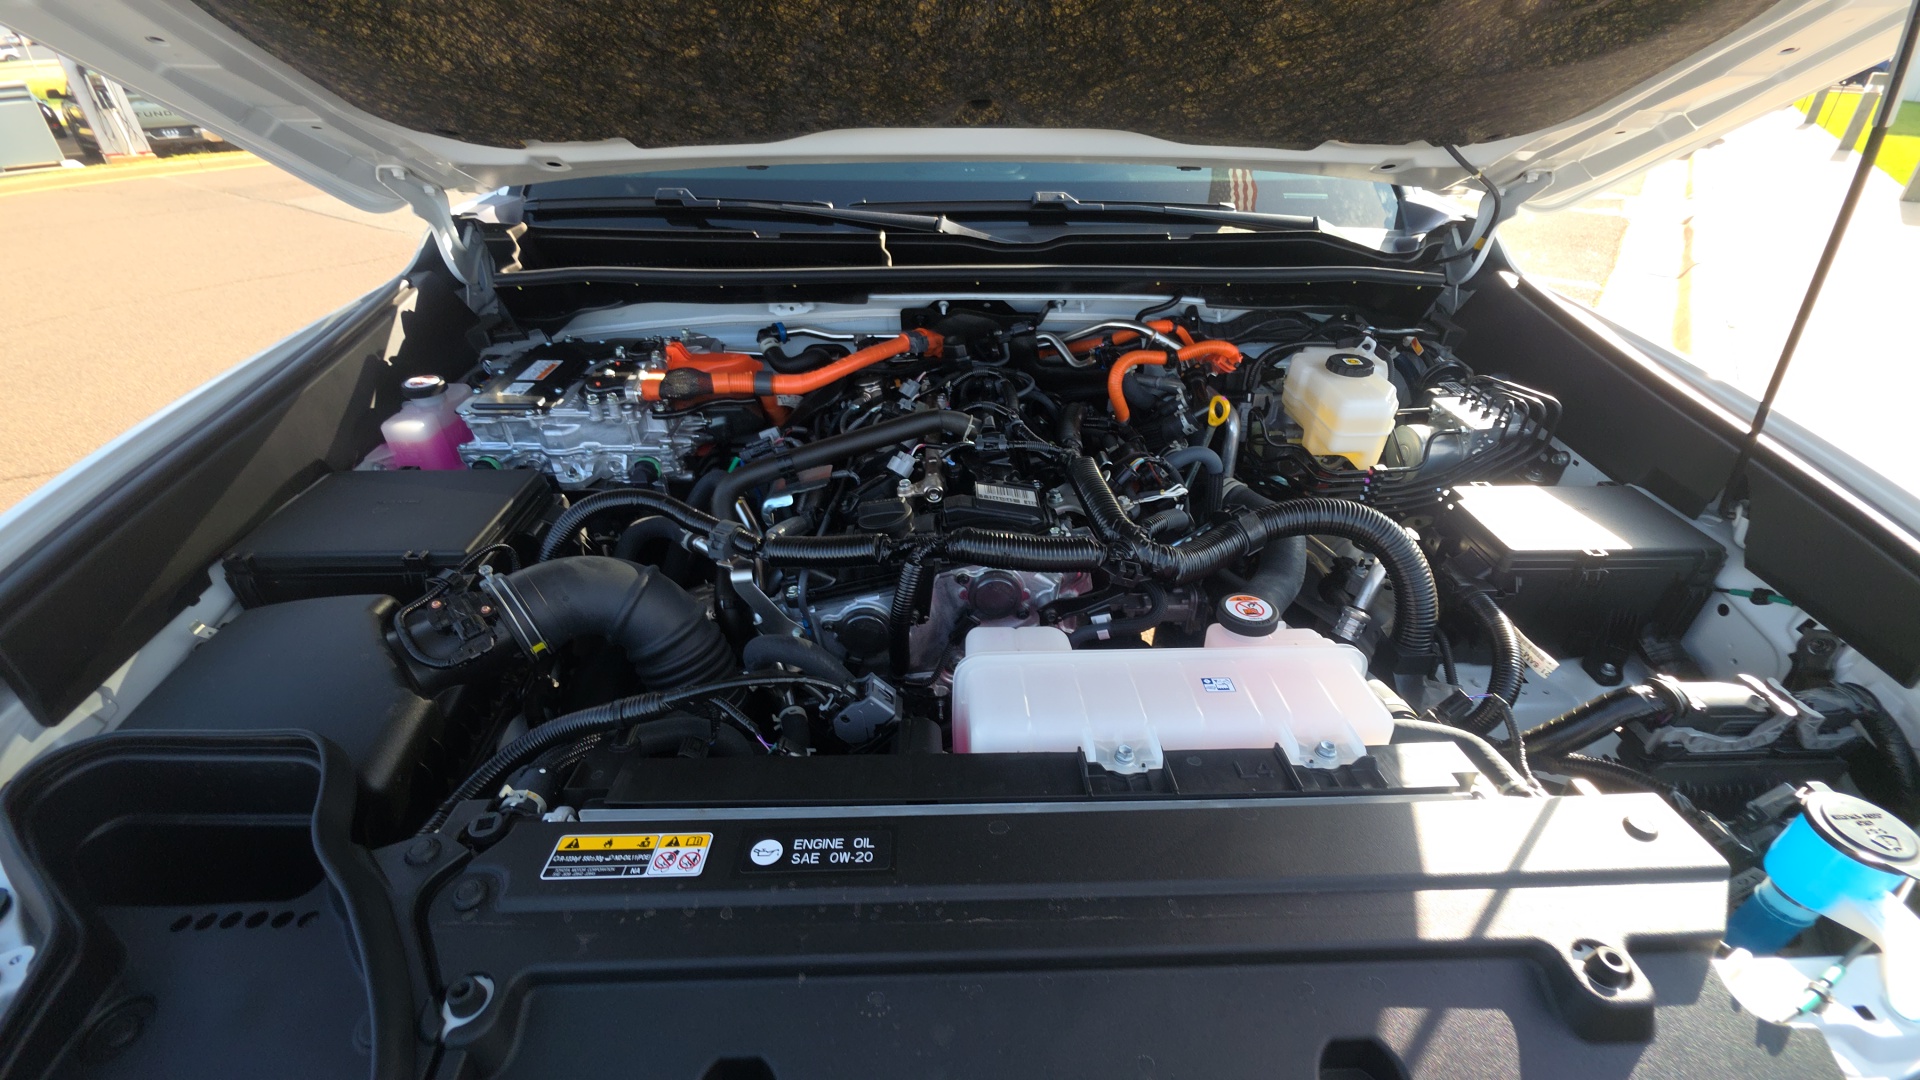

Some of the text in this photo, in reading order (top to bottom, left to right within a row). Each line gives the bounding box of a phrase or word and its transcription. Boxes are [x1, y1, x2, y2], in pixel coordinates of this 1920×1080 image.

[793, 837, 875, 850] ENGINE OIL
[791, 851, 874, 865] SAE 0W-20
